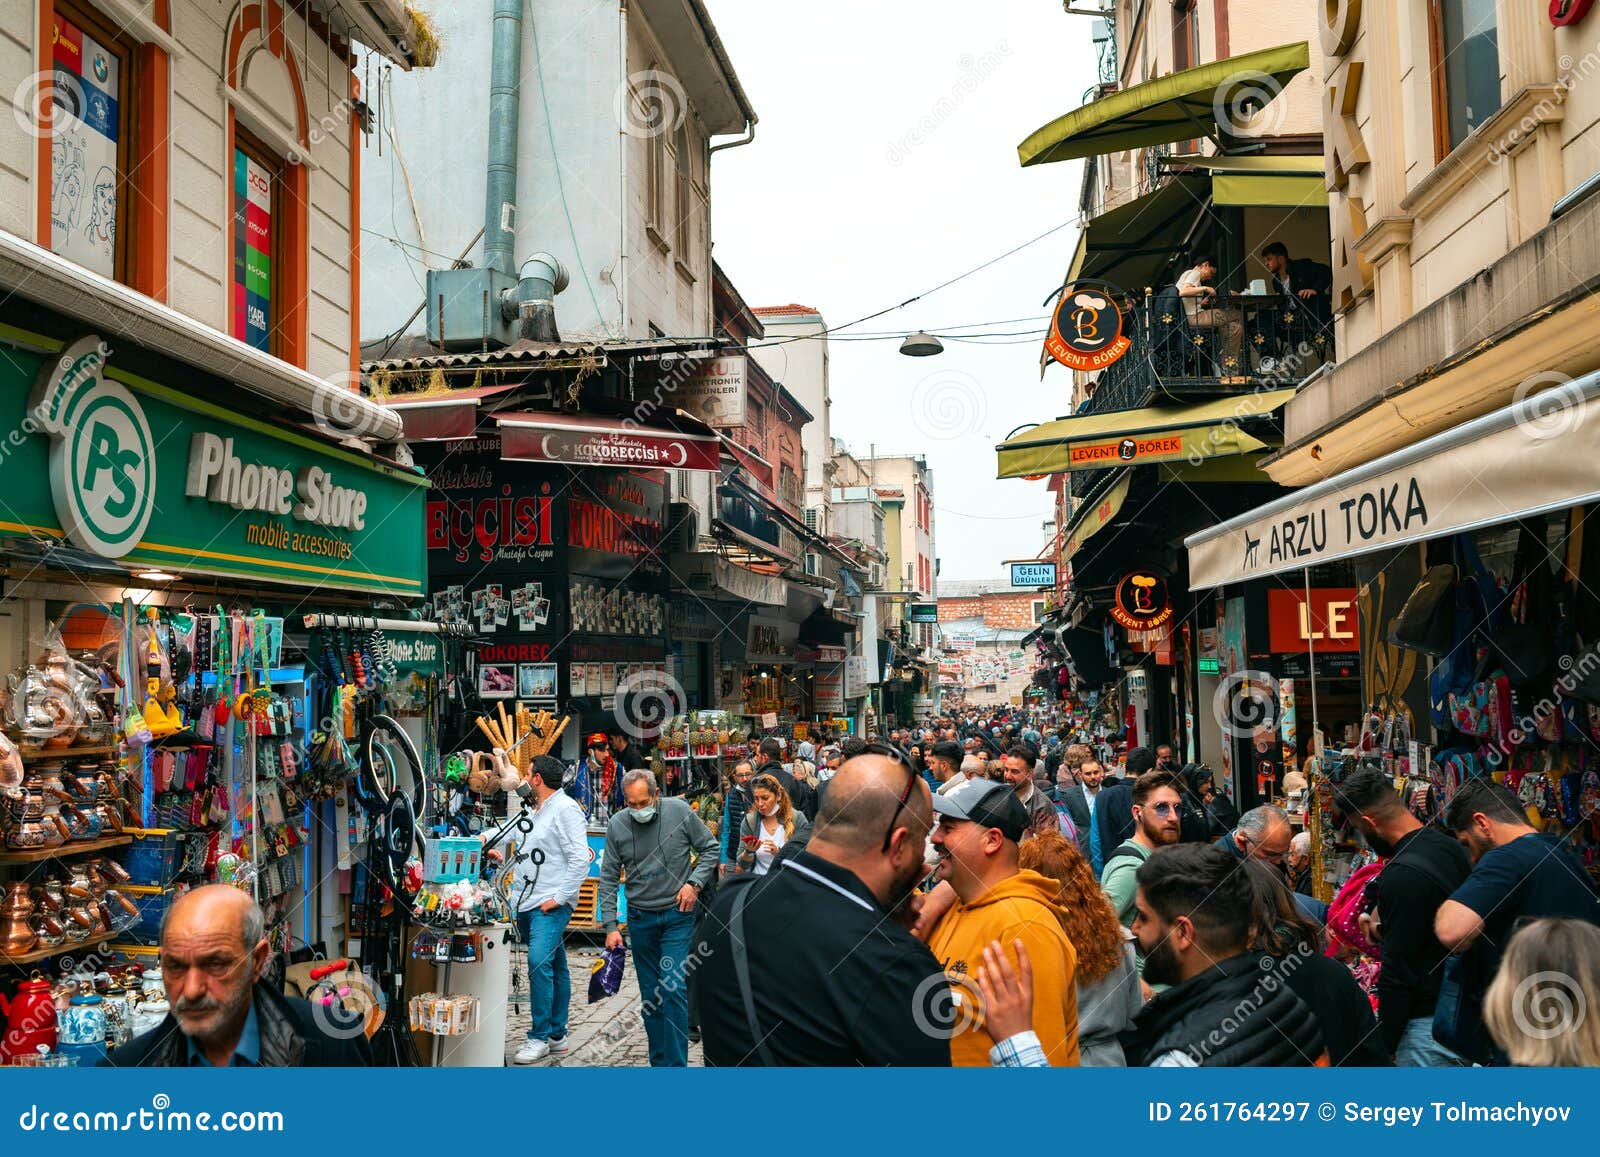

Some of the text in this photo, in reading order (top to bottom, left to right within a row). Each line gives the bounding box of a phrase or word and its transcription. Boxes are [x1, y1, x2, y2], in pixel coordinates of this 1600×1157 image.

[1049, 339, 1127, 366] LEVENT BÖREK
[1072, 439, 1179, 461] LEVENT BÖREK
[83, 420, 142, 519] PS
[185, 432, 368, 531] Phone Store
[1269, 476, 1428, 564] ARZU TOKA
[246, 521, 353, 561] mobile accessories
[1014, 575, 1054, 584] ÜRÜNLERİ
[1019, 566, 1050, 576] GELİN
[1113, 608, 1144, 629] LEVENT
[1298, 601, 1358, 640] LE
[387, 639, 437, 661] Phone Store
